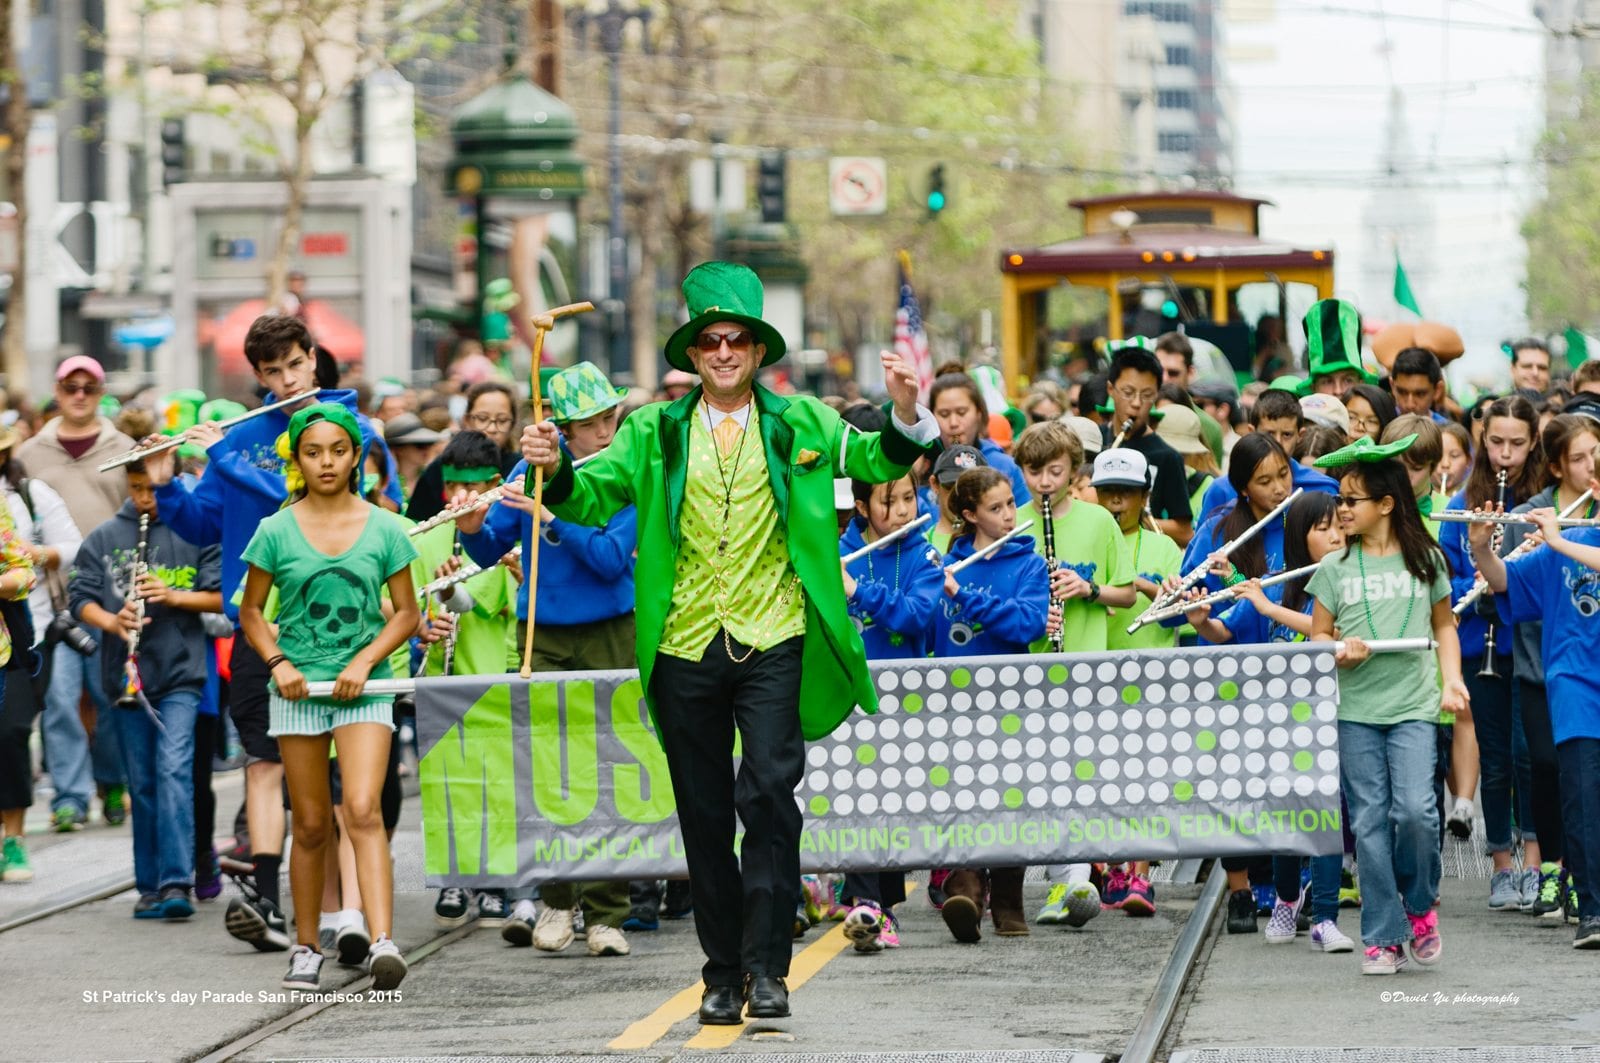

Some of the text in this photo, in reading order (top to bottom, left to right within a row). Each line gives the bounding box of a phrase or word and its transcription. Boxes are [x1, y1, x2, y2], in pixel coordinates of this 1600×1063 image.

[419, 679, 742, 876] MUS
[535, 837, 660, 862] MUSICAL
[918, 820, 1060, 850] THROUGH
[1068, 815, 1171, 843] SOUND
[1179, 808, 1340, 838] EDUCATION
